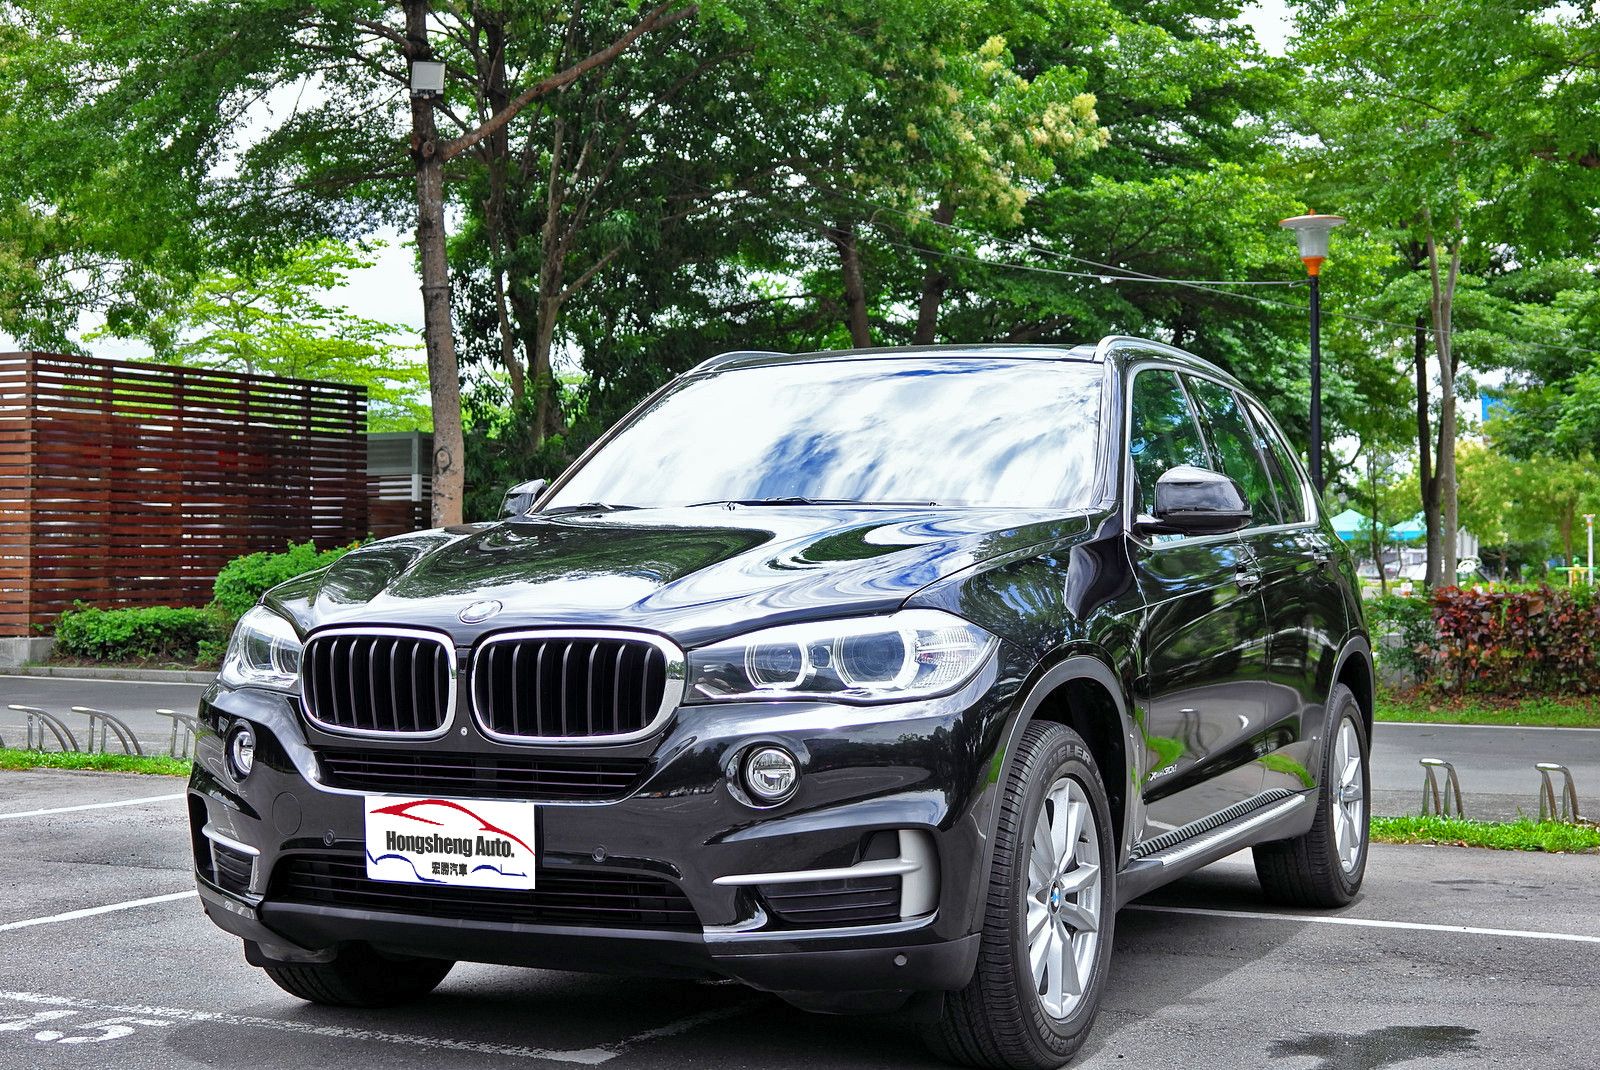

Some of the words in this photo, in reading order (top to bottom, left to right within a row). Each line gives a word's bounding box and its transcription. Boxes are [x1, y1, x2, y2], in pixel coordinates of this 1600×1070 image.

[386, 831, 472, 857] Hongsheng
[475, 836, 515, 858] Auto.
[432, 861, 467, 877] 宏勝汽車
